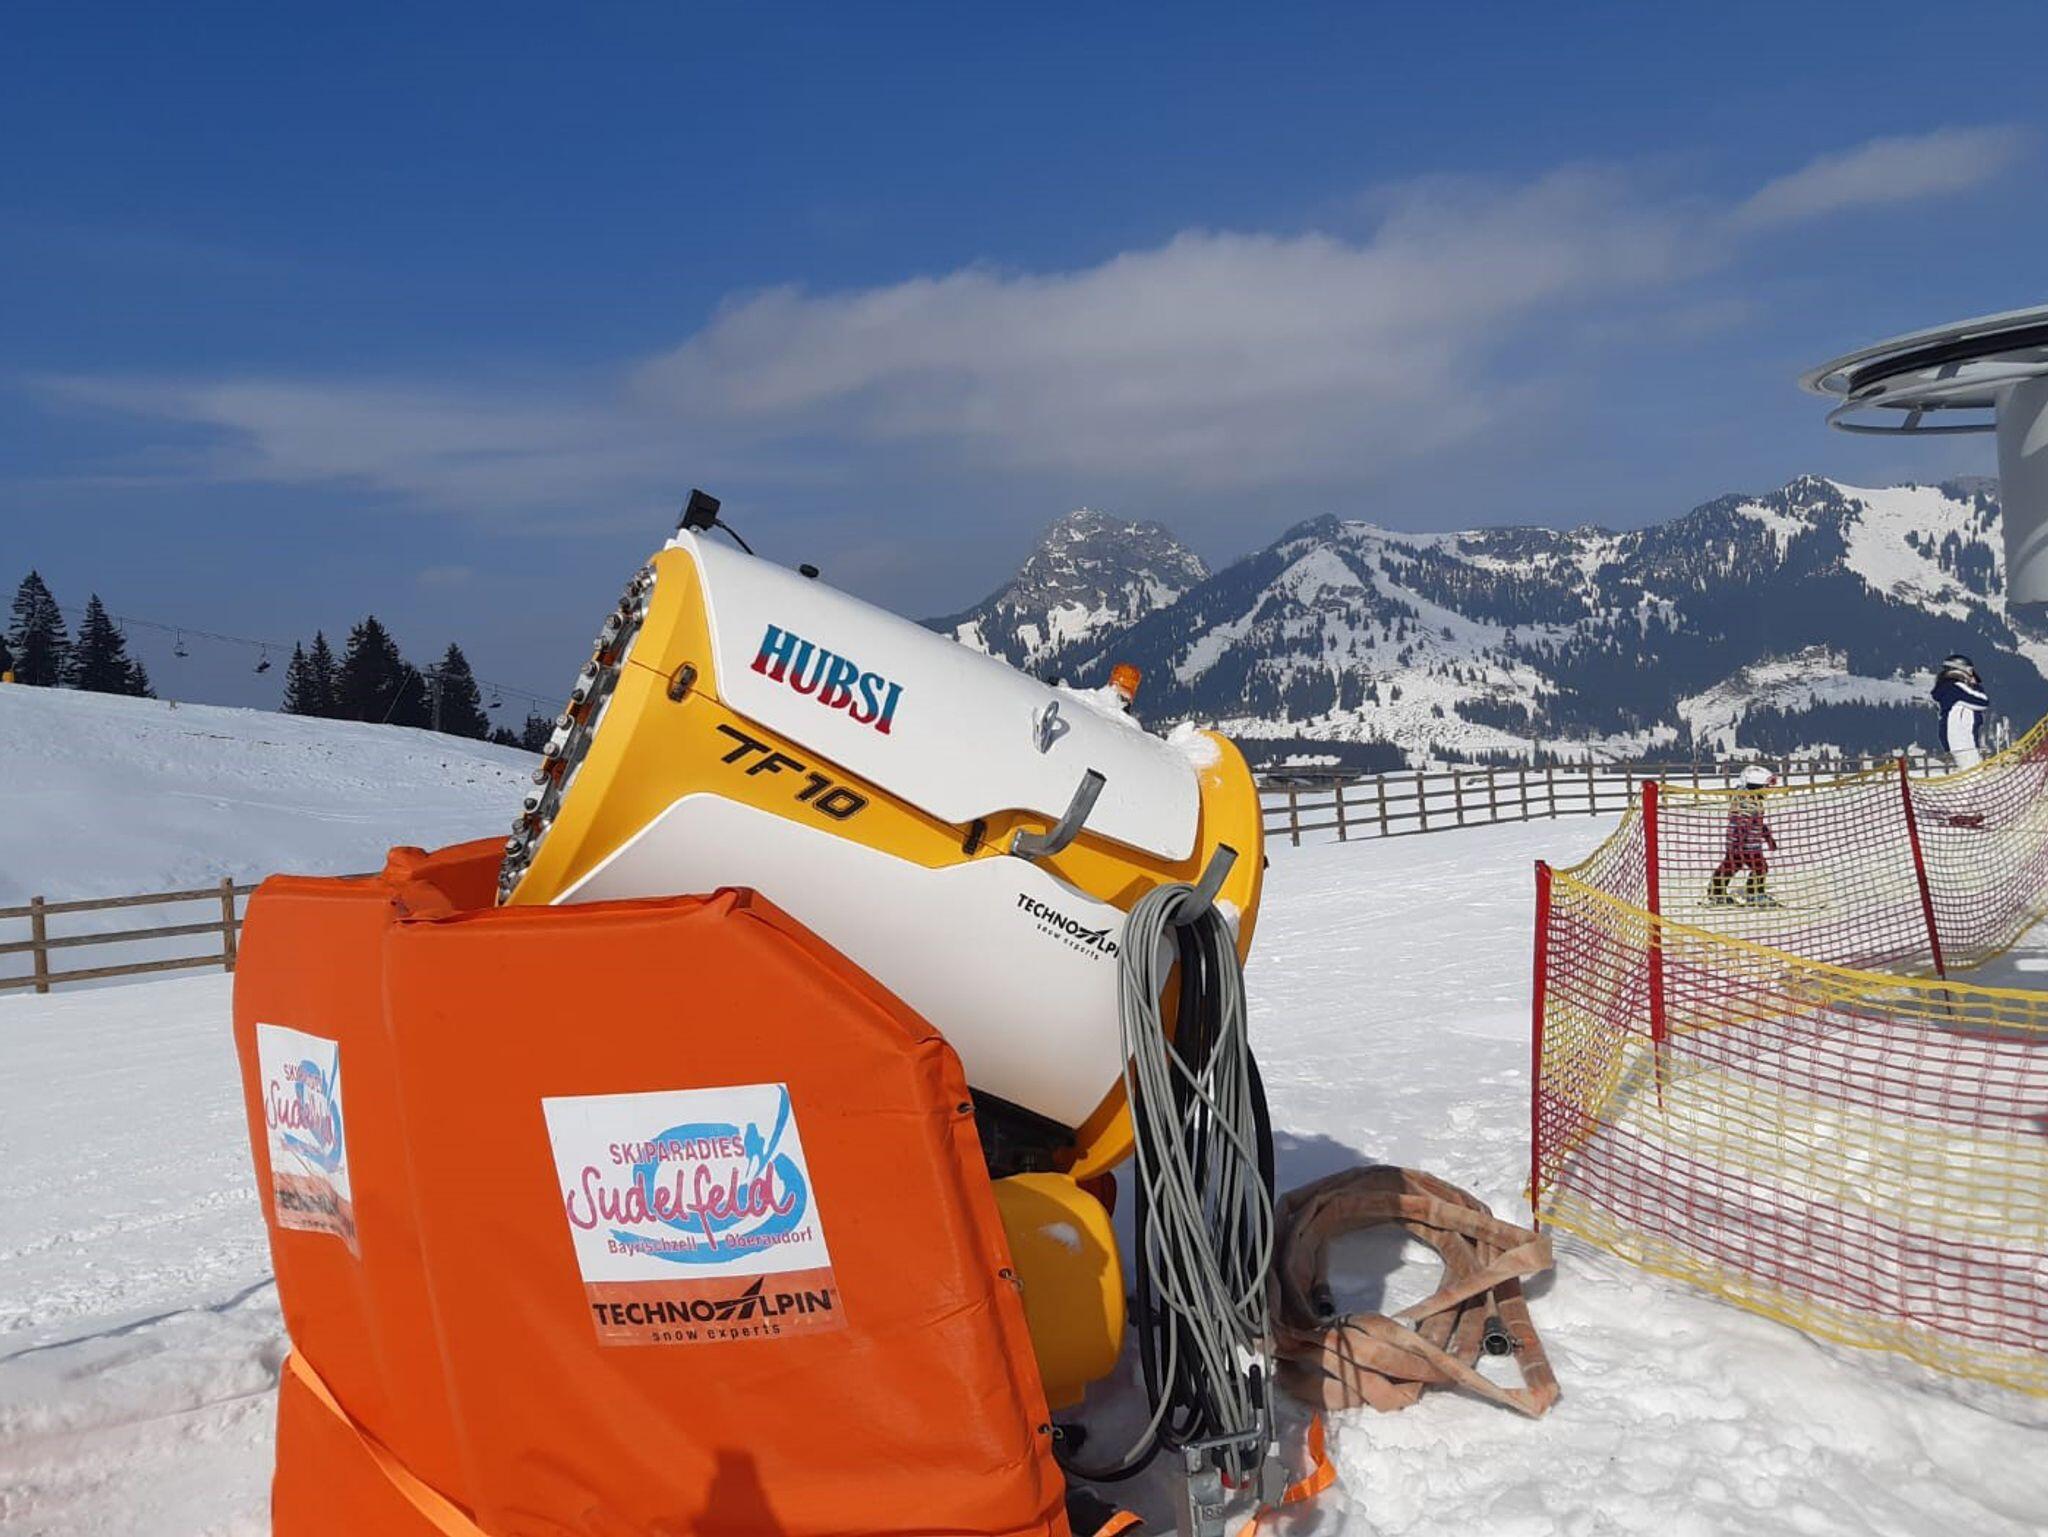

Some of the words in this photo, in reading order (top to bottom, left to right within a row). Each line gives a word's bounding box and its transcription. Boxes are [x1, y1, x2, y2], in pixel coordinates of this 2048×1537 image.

[751, 624, 903, 735] HUBSI
[716, 723, 869, 821] TF10
[1017, 892, 1120, 959] TECHNOALPI
[609, 1134, 745, 1165] SKIPARADIES
[566, 1161, 795, 1251] Sudelfeld
[607, 1236, 697, 1257] Bayrischzell
[724, 1226, 813, 1248] Oberaudorf
[592, 1276, 833, 1326] TECHNOALPIN
[652, 1330, 698, 1342] snow
[708, 1324, 781, 1341] experts
